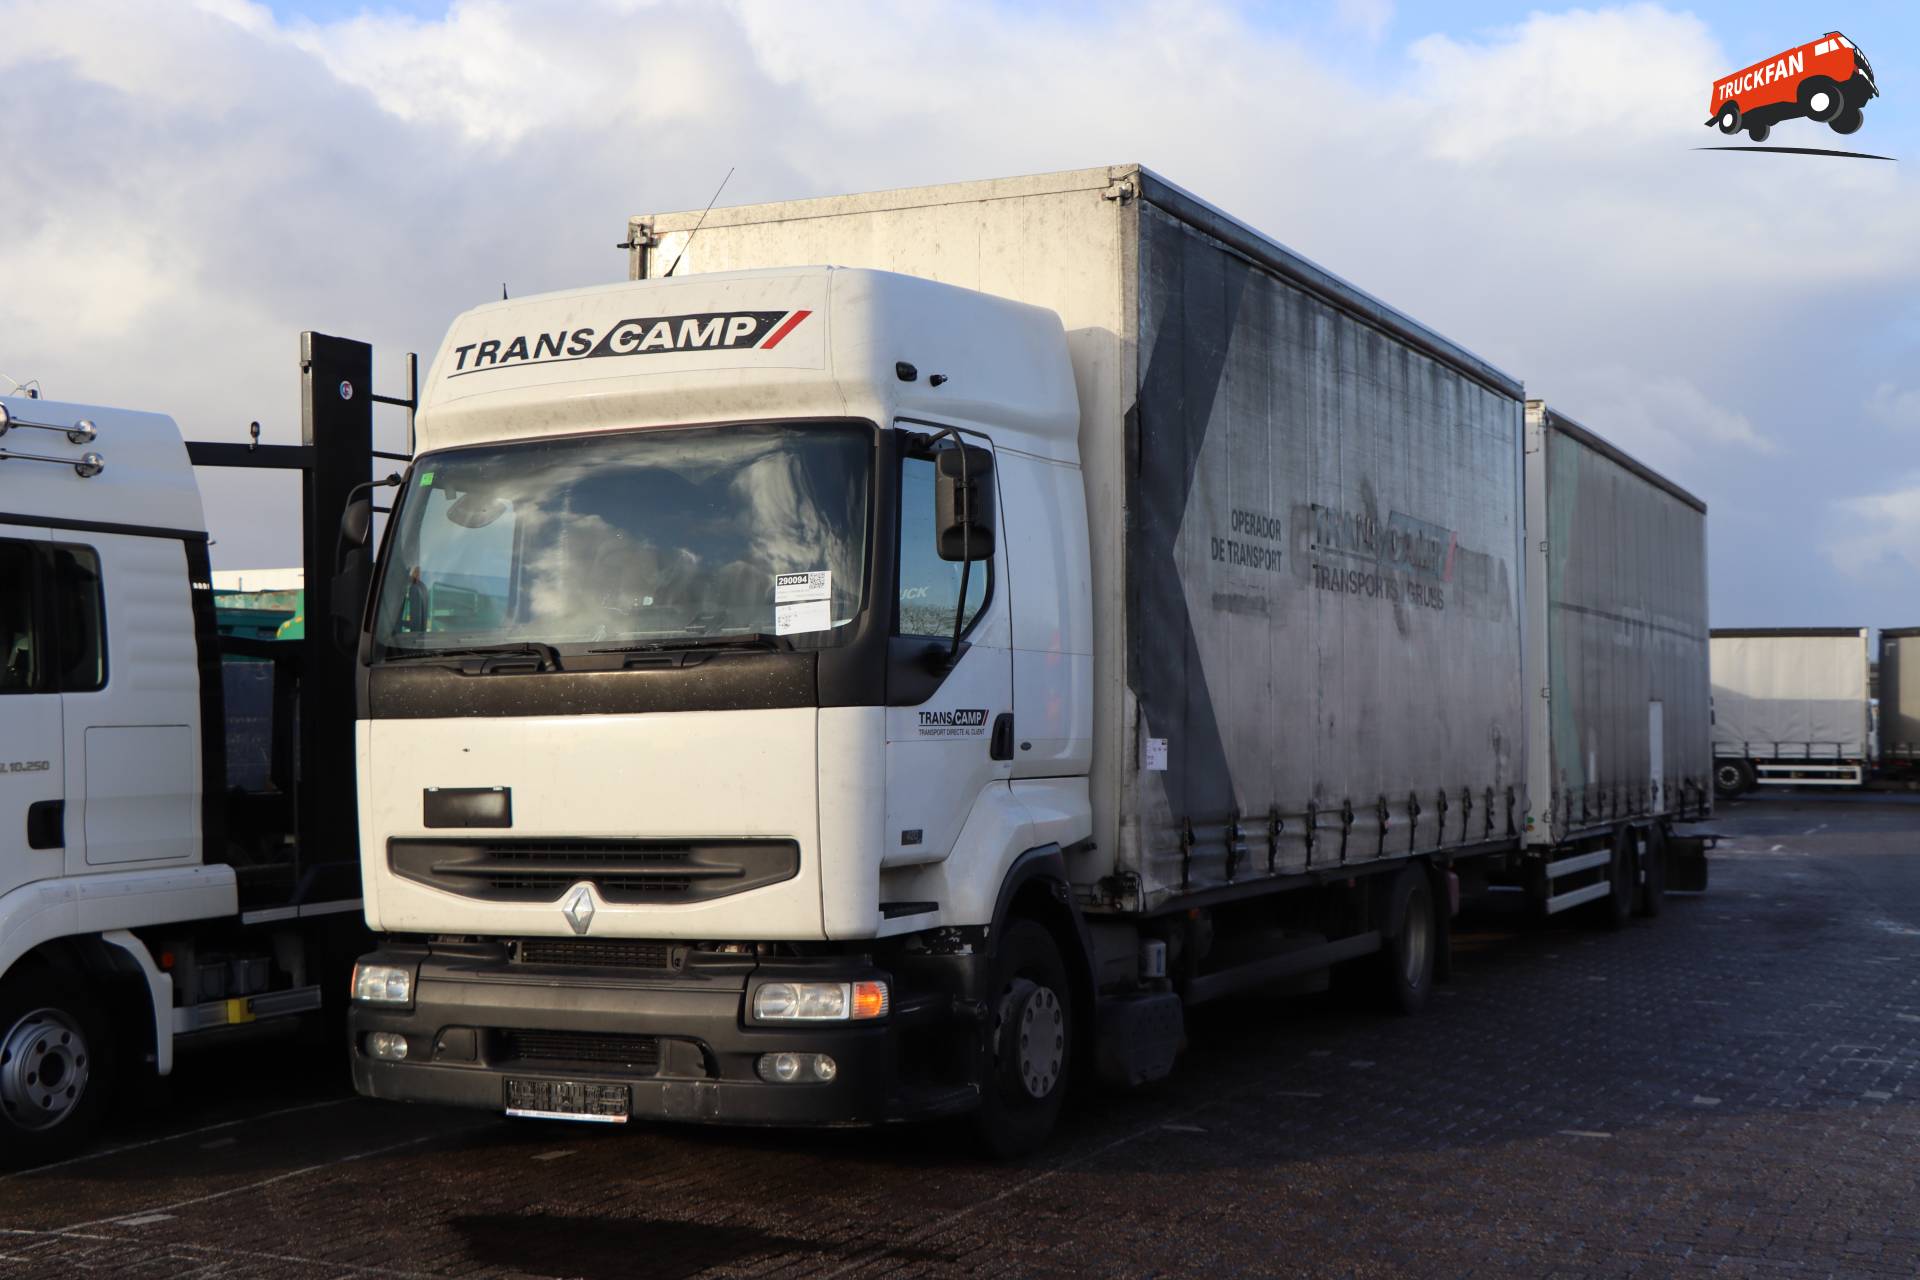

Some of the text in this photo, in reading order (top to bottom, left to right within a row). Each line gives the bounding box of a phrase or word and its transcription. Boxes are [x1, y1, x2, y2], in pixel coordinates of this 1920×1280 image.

[1231, 508, 1282, 542] OPERADOR
[1211, 536, 1282, 573] DE TRANSPORT
[919, 728, 945, 736] TRANSPORT
